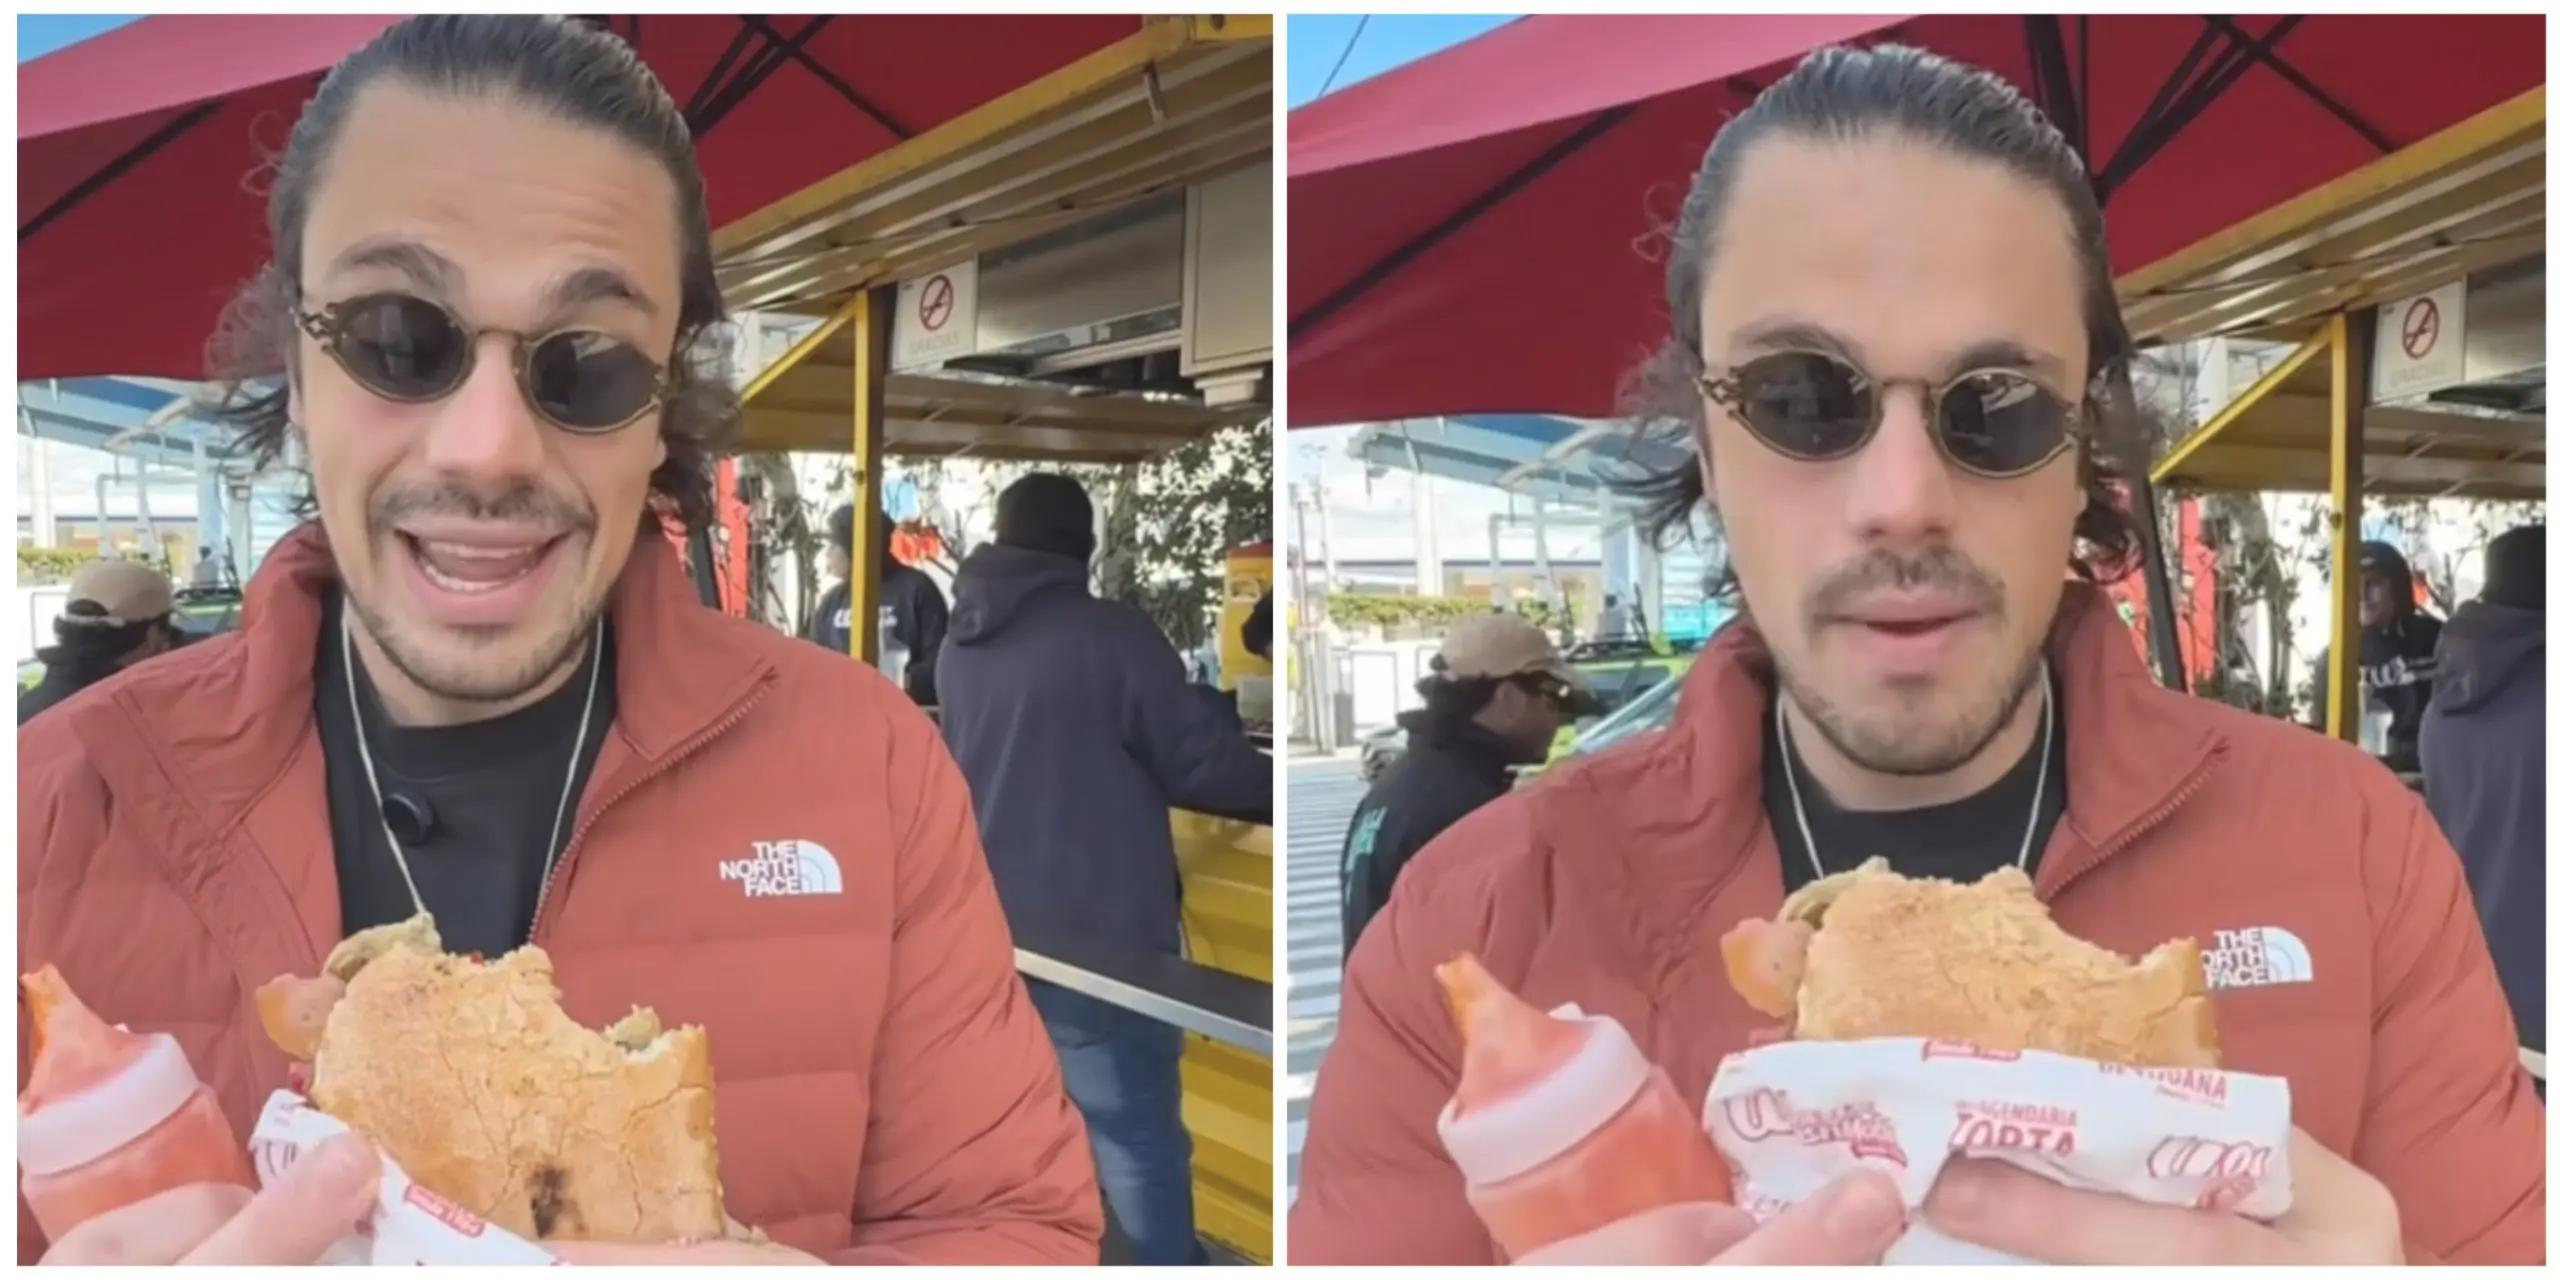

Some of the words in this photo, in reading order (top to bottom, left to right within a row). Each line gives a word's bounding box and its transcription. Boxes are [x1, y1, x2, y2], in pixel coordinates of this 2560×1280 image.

[751, 840, 798, 861] THE
[719, 859, 798, 880] NORTH
[744, 878, 801, 897] FACE
[2213, 928, 2262, 951] THE
[2200, 946, 2265, 971] ORTH
[2205, 966, 2268, 989] FACE
